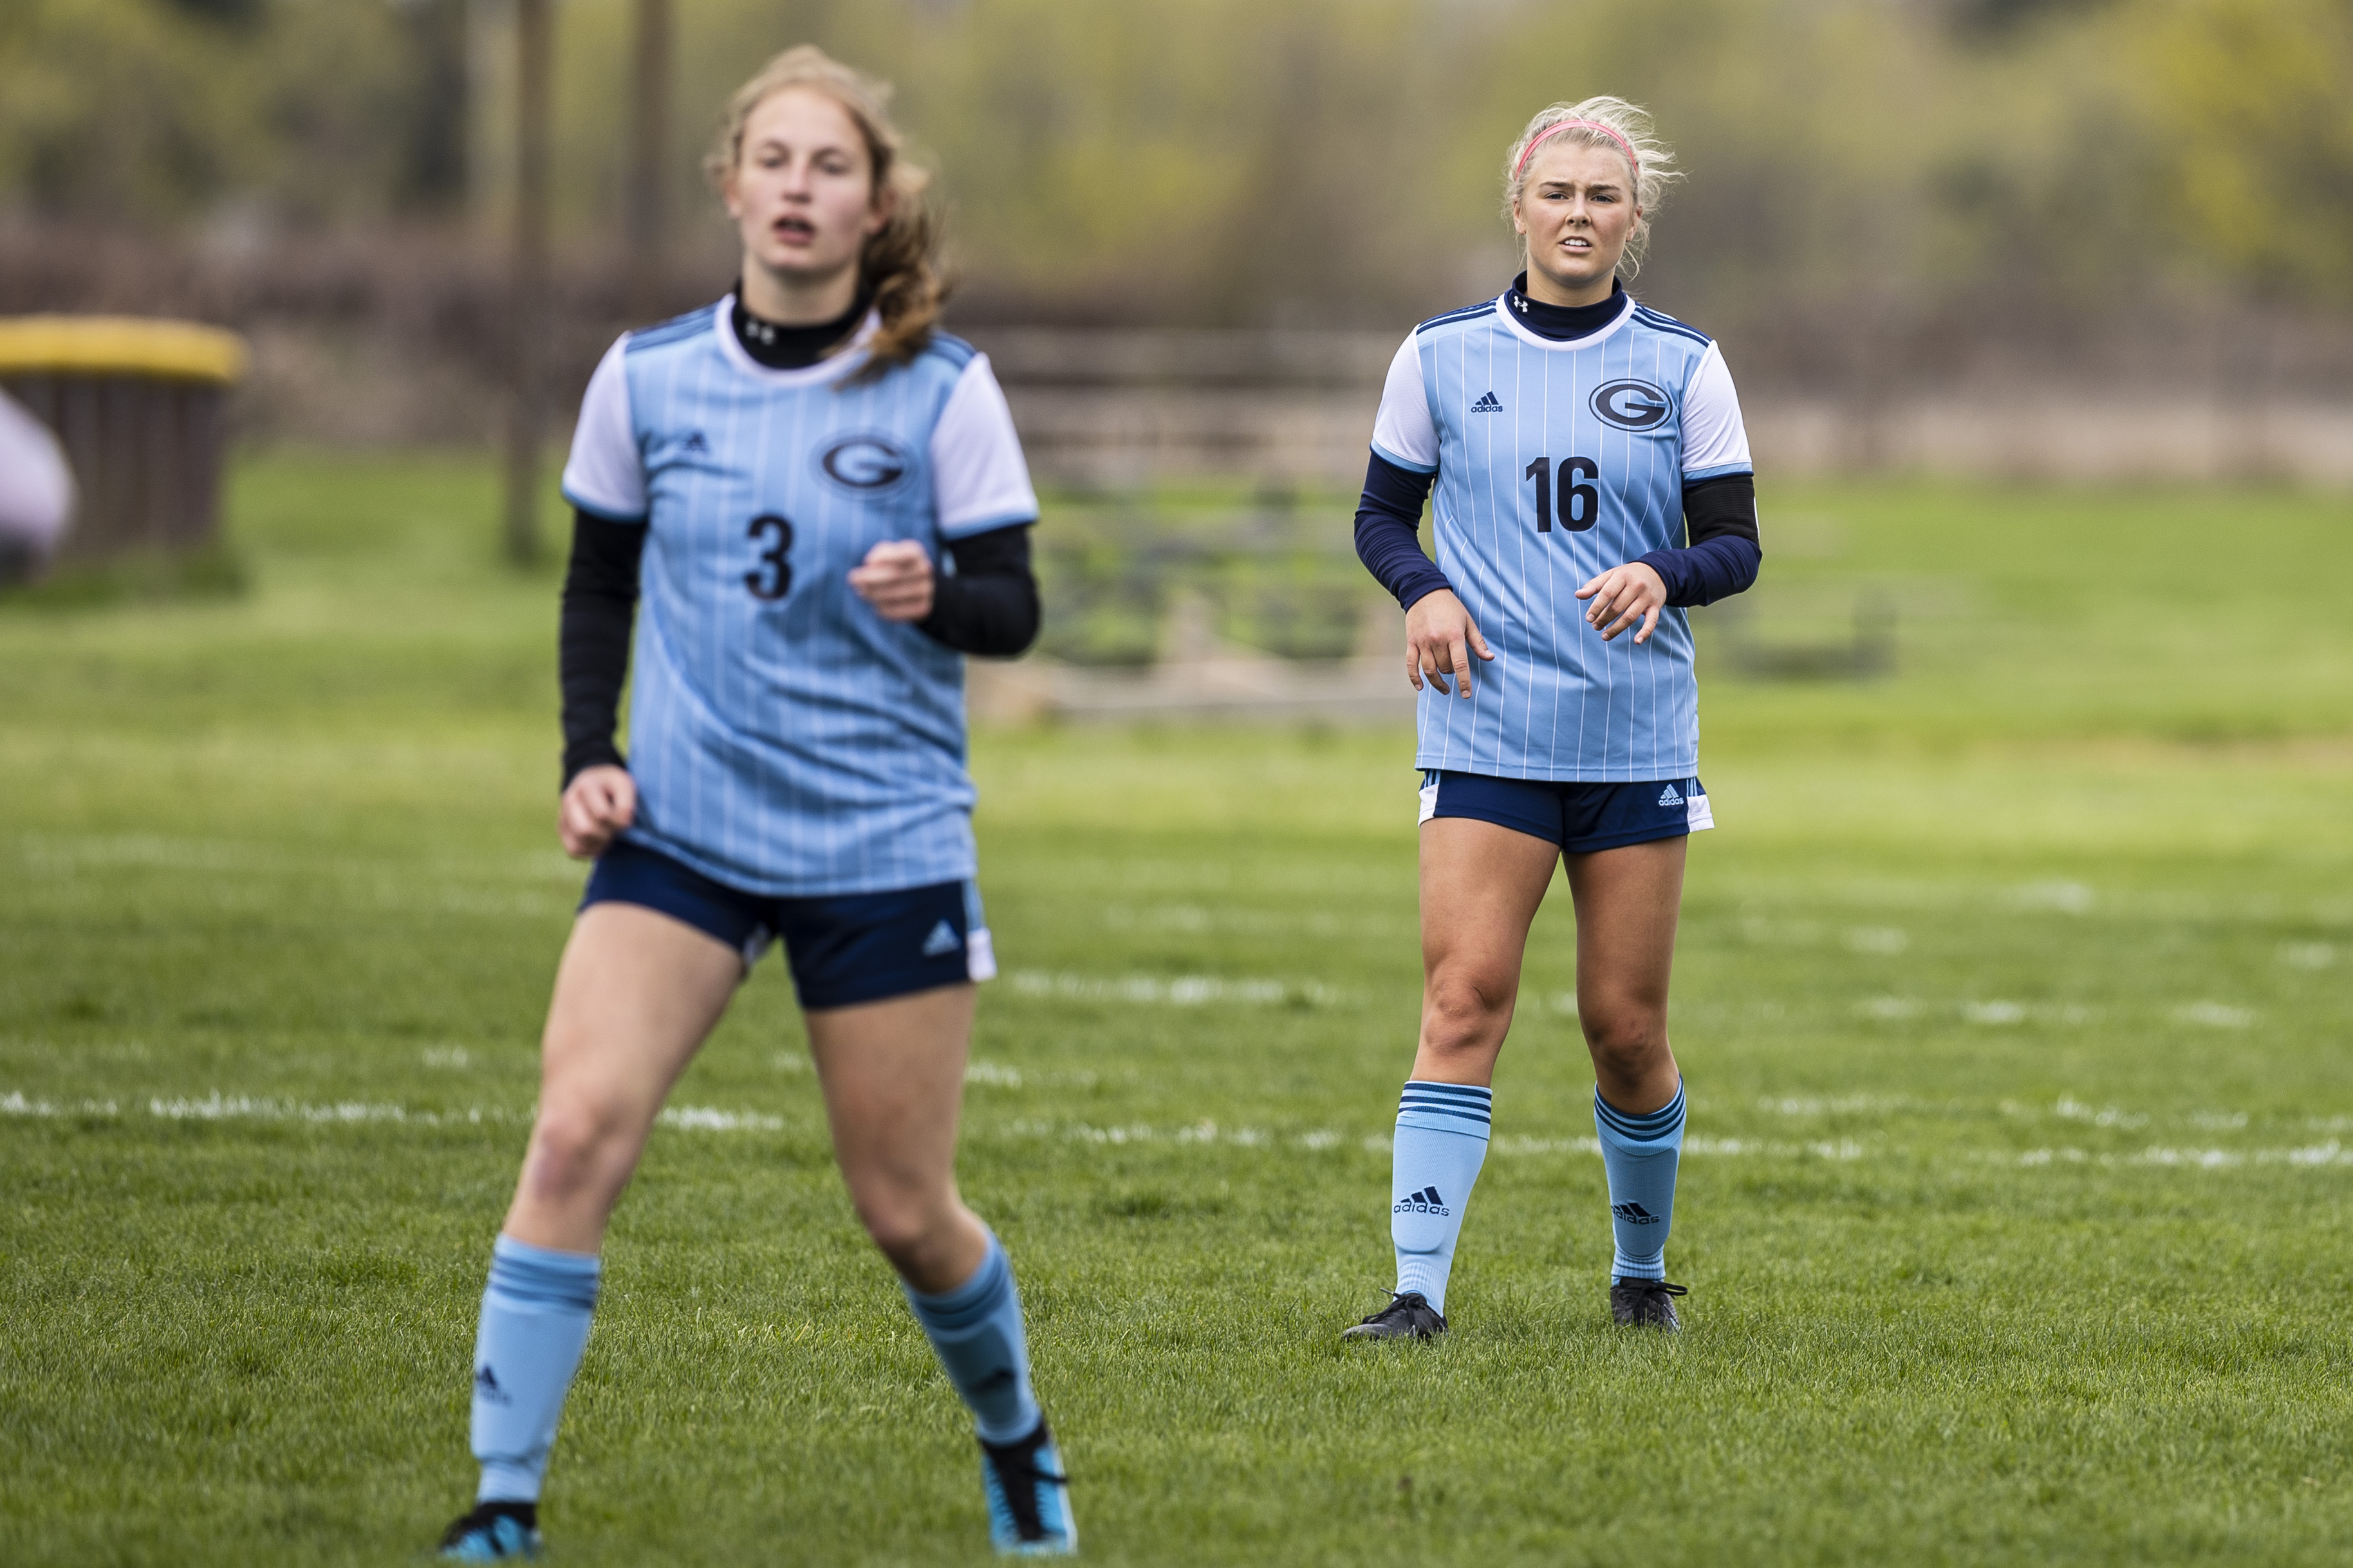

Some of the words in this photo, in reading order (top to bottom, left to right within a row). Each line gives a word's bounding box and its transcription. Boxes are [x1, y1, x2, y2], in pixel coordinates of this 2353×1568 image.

[1595, 384, 1666, 426] G
[823, 436, 903, 489] G
[1526, 456, 1599, 533] 16
[745, 515, 792, 602] 3
[1659, 797, 1684, 806] adidas
[1393, 1202, 1450, 1217] adidas
